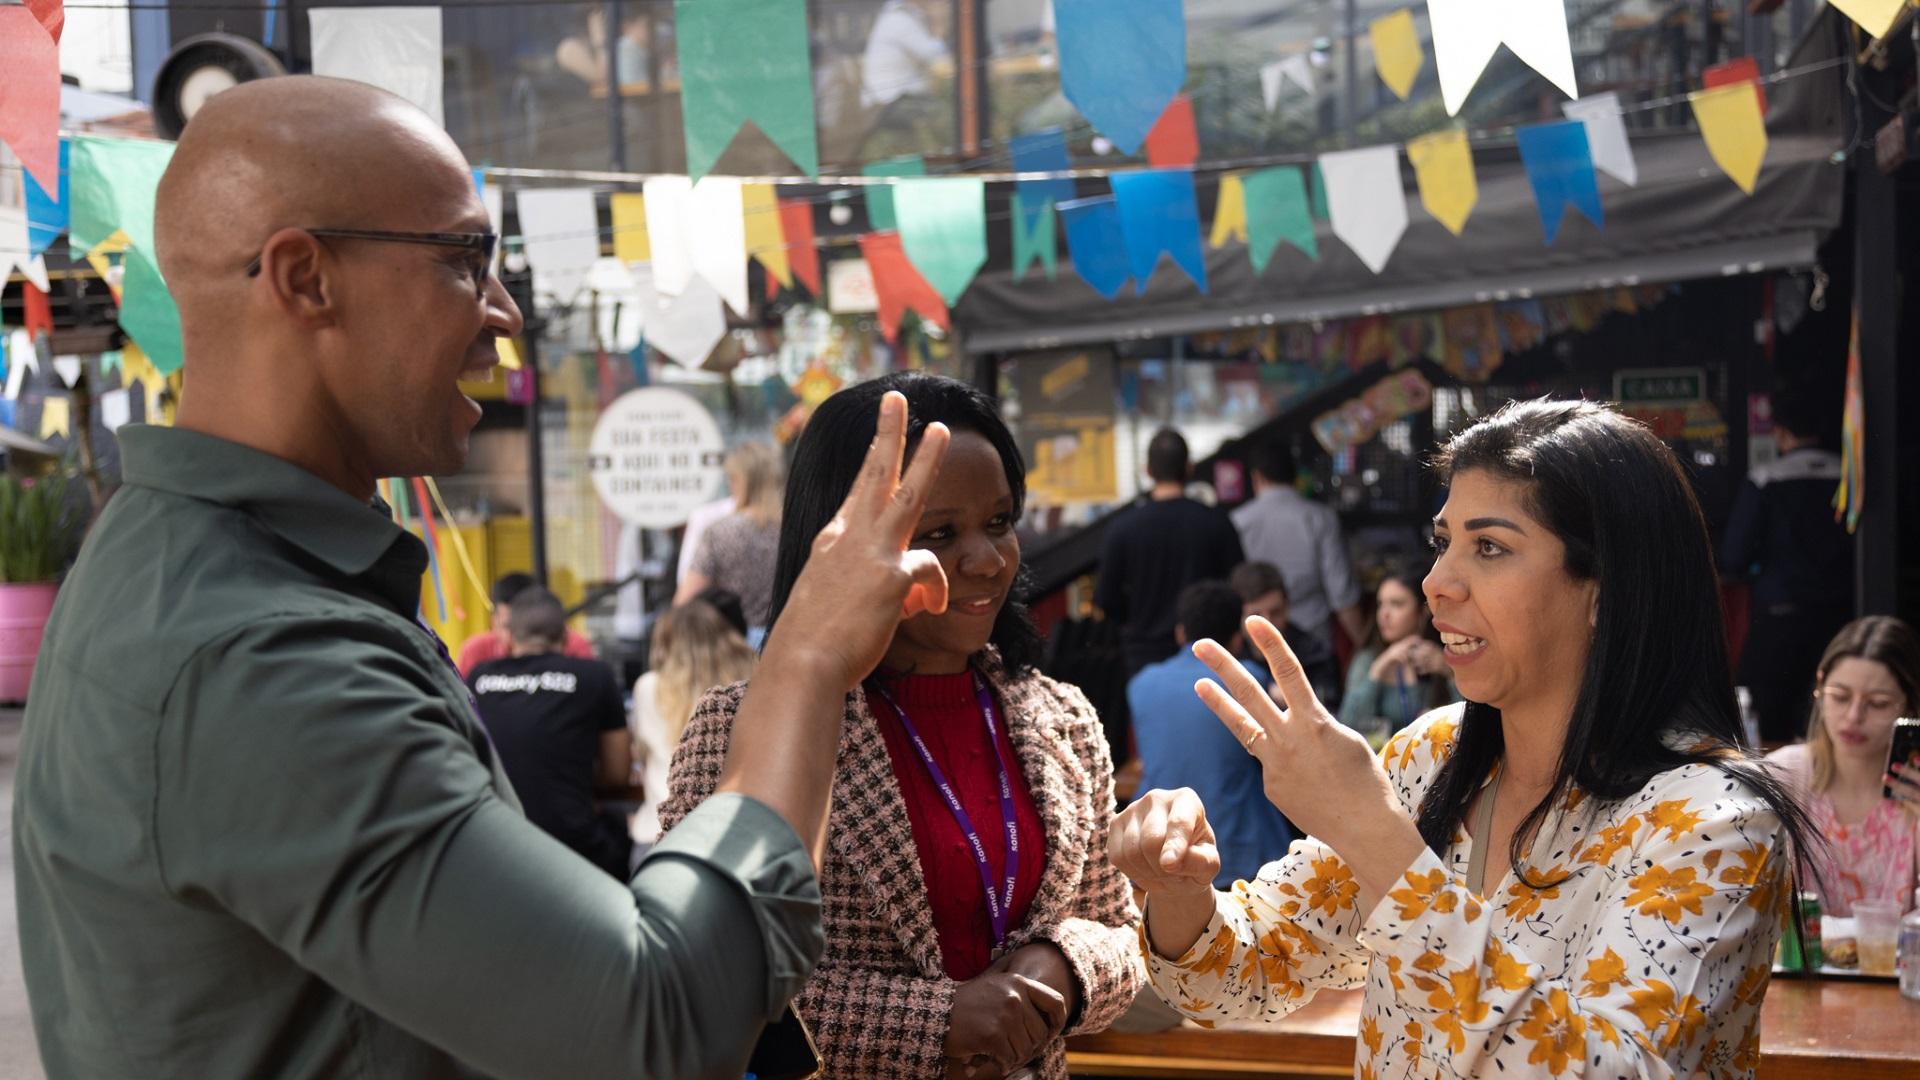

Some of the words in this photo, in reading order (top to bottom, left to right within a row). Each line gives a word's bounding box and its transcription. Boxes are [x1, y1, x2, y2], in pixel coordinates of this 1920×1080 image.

[649, 426, 700, 445] FESTA
[941, 783, 962, 811] sanofi
[968, 832, 987, 863] sanofi
[1007, 821, 1018, 852] sanofi
[986, 886, 999, 918] sanofi
[1004, 876, 1016, 909] sanofi
